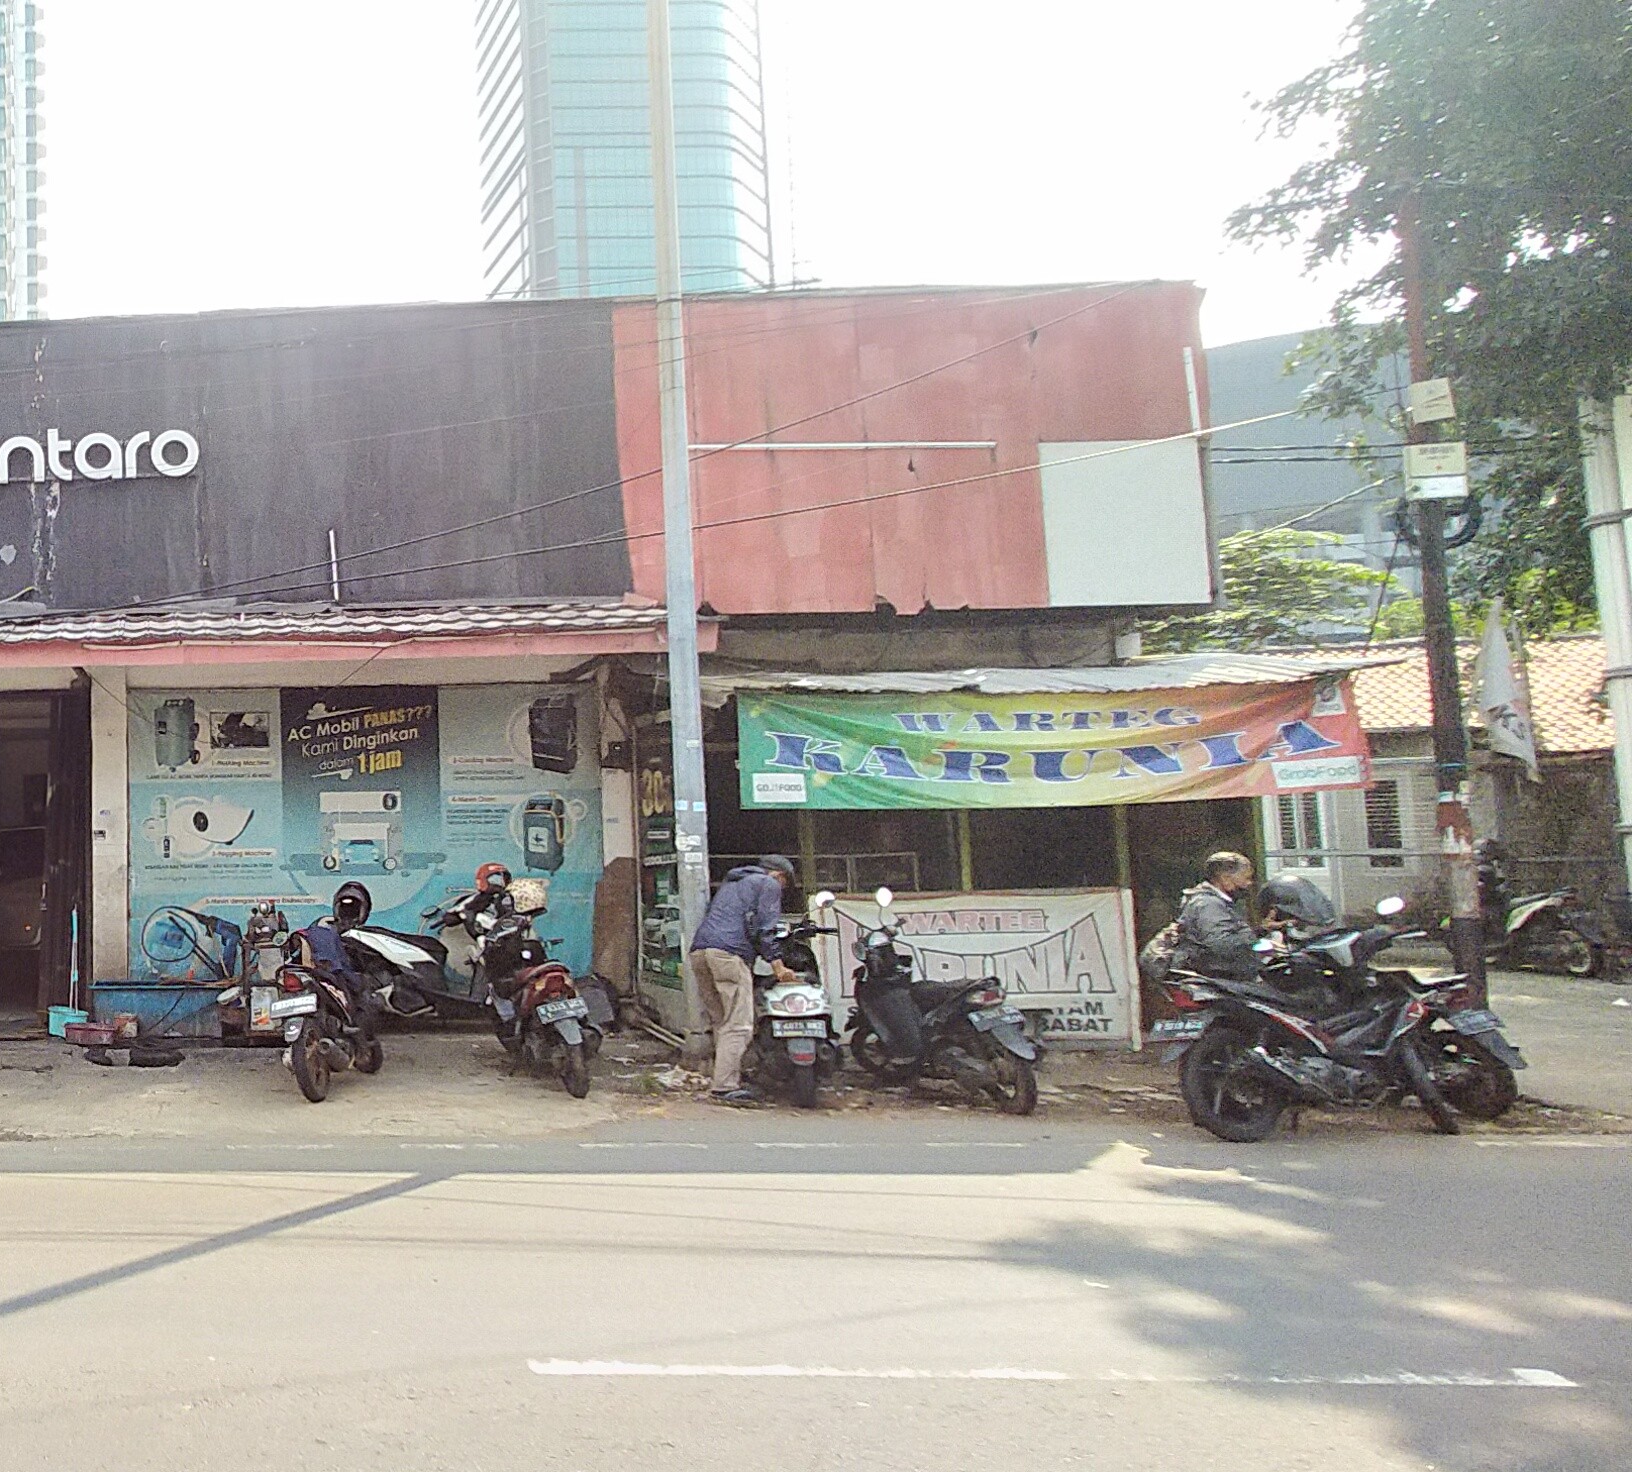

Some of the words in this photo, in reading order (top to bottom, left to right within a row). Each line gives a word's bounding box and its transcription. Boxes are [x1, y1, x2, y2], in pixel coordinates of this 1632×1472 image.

[287, 725, 312, 742] AC
[316, 717, 360, 737] Mobil
[892, 706, 1202, 734] WARTEG
[301, 738, 339, 758] Kami
[343, 727, 419, 751] Dinginkan
[764, 719, 1344, 784] KARUNIA
[319, 757, 355, 771] dalam
[369, 749, 403, 775] jam
[898, 910, 1047, 935] WARTEG
[833, 906, 1117, 999] KRUNIA
